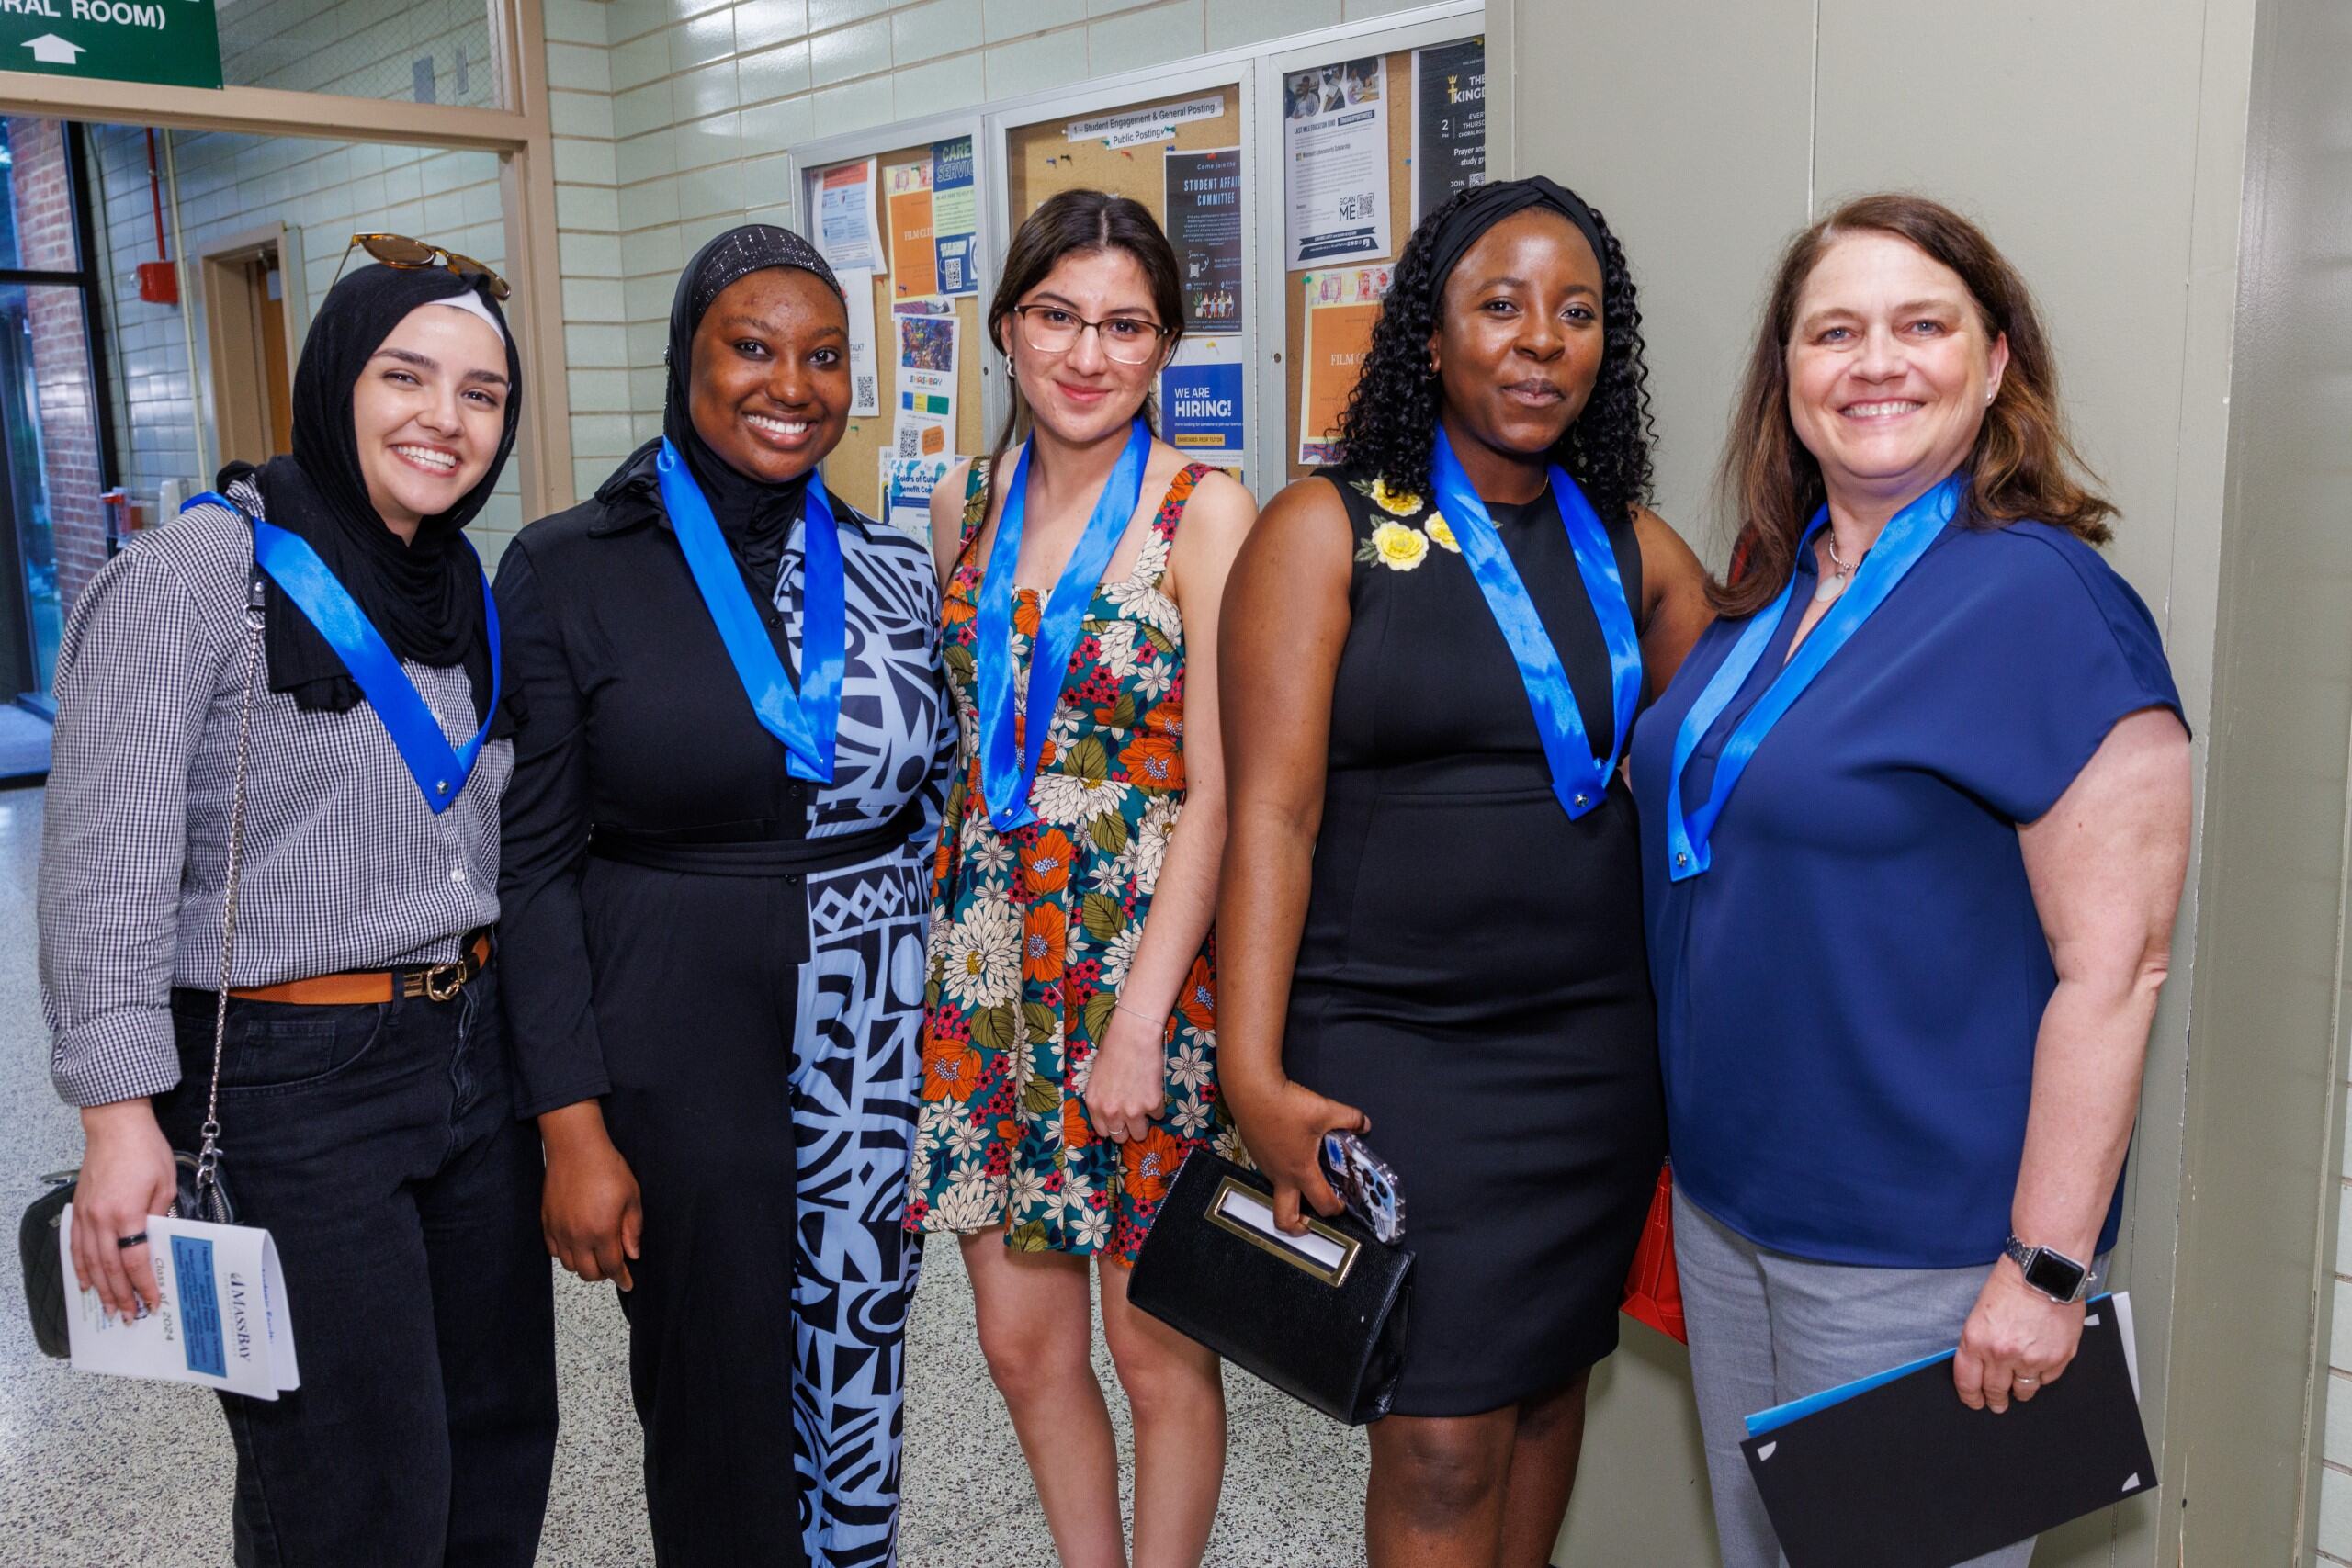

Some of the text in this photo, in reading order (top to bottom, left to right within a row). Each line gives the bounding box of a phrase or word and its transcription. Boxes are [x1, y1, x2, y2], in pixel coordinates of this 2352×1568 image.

[0, 0, 166, 30] RAL ROOM)
[1084, 120, 1109, 133] Student
[1110, 114, 1151, 129] Engagement
[1152, 113, 1158, 121] &
[1159, 106, 1186, 119] General
[1469, 112, 1485, 120] EVER
[1442, 119, 1449, 130] 2
[1113, 131, 1135, 145] Public
[1454, 147, 1474, 156] Prayer
[1461, 156, 1477, 166] study
[1183, 177, 1217, 192] STUDENT
[1450, 179, 1465, 187] JOIN
[1197, 192, 1235, 207] COMMITTEE
[1340, 196, 1356, 206] SCAN
[1340, 204, 1356, 221] ME
[1330, 353, 1354, 366] FILM
[1174, 387, 1210, 398] WE ARE
[1175, 400, 1232, 417] HIRING!
[916, 475, 922, 483] of
[154, 1258, 165, 1288] Class
[162, 1311, 175, 1342] 2024
